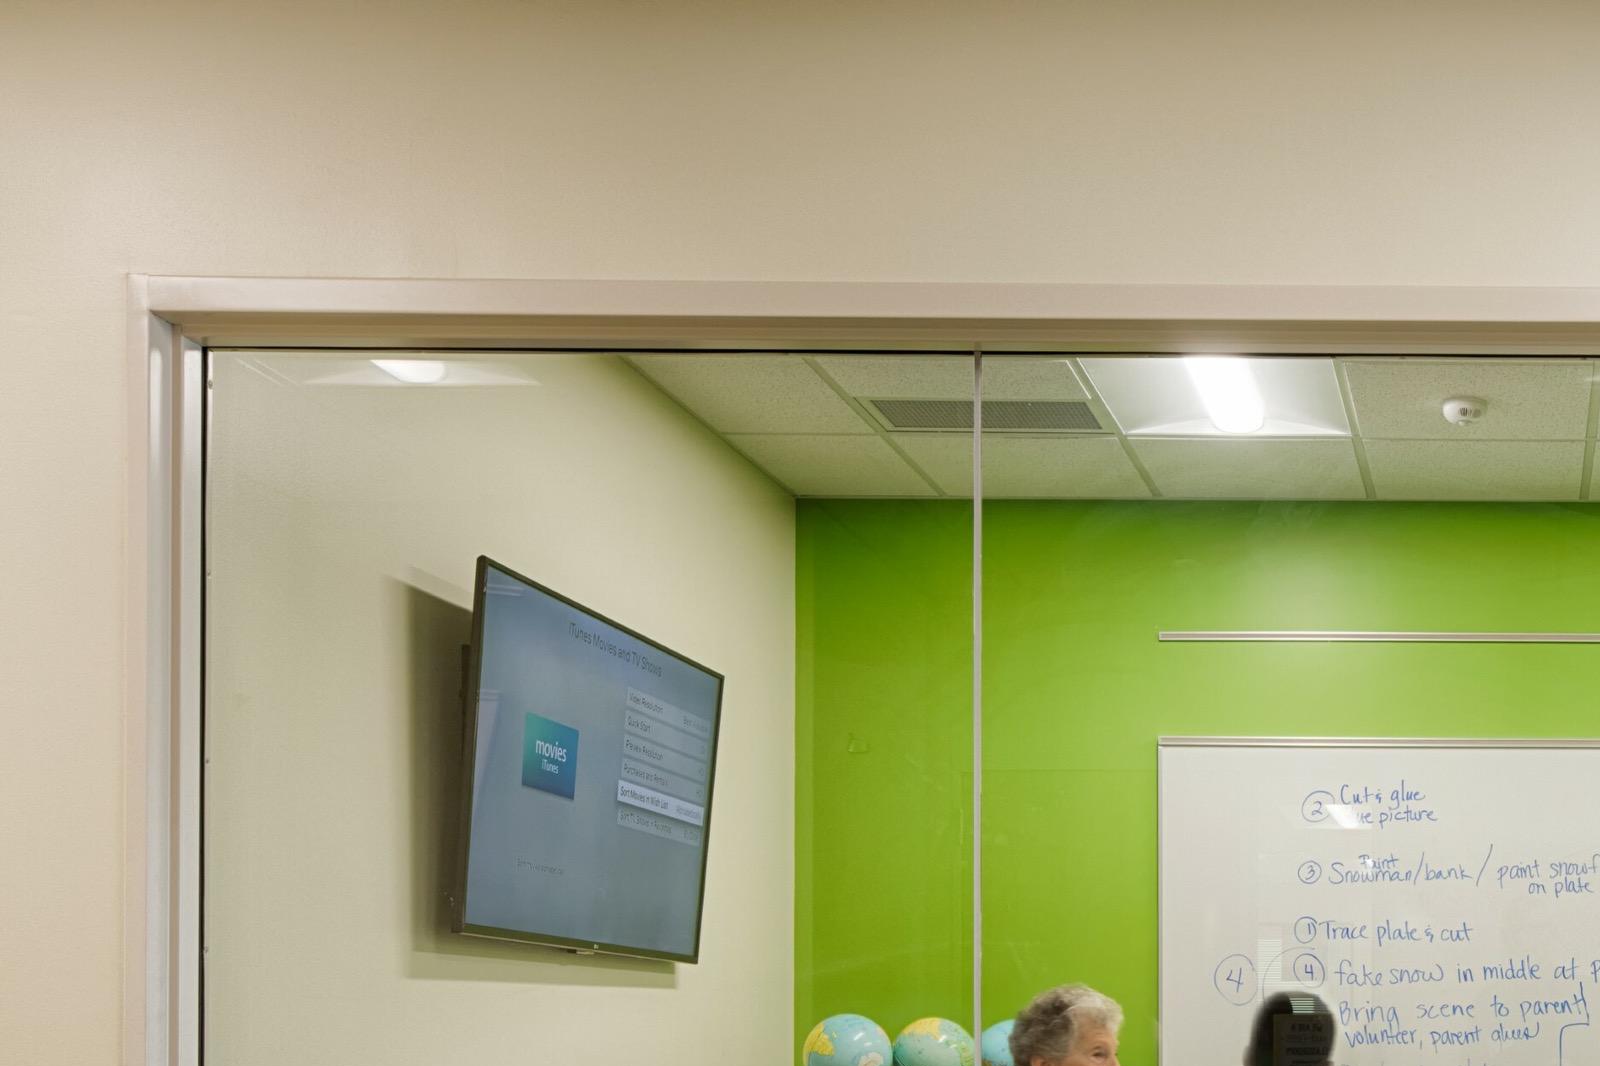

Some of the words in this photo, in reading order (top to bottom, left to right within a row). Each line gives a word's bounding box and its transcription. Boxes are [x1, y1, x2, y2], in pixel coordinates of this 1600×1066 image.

[568, 622, 592, 645] iTunes
[592, 633, 617, 657] Movies
[617, 645, 630, 663] and
[630, 652, 640, 668] TV
[641, 657, 661, 678] Shows
[535, 737, 566, 762] movies
[541, 759, 558, 775] iTunes
[1340, 784, 1373, 804] Cut
[1388, 779, 1426, 810] glue
[1378, 805, 1438, 830] picture
[1497, 859, 1540, 889] paint
[1528, 881, 1546, 895] on
[1554, 877, 1594, 898] plate
[1318, 920, 1369, 940] Trace
[1376, 919, 1422, 947] plate
[1440, 922, 1472, 942] cut
[1334, 959, 1383, 986] fake
[1389, 964, 1444, 986] snow
[1457, 964, 1474, 983] in
[1483, 954, 1541, 980] middle
[1554, 957, 1578, 980] at
[1339, 1001, 1400, 1032] Bring
[1416, 1002, 1476, 1020] scene
[1490, 994, 1510, 1018] to
[1520, 993, 1587, 1022] parent
[1430, 1025, 1482, 1054] parent
